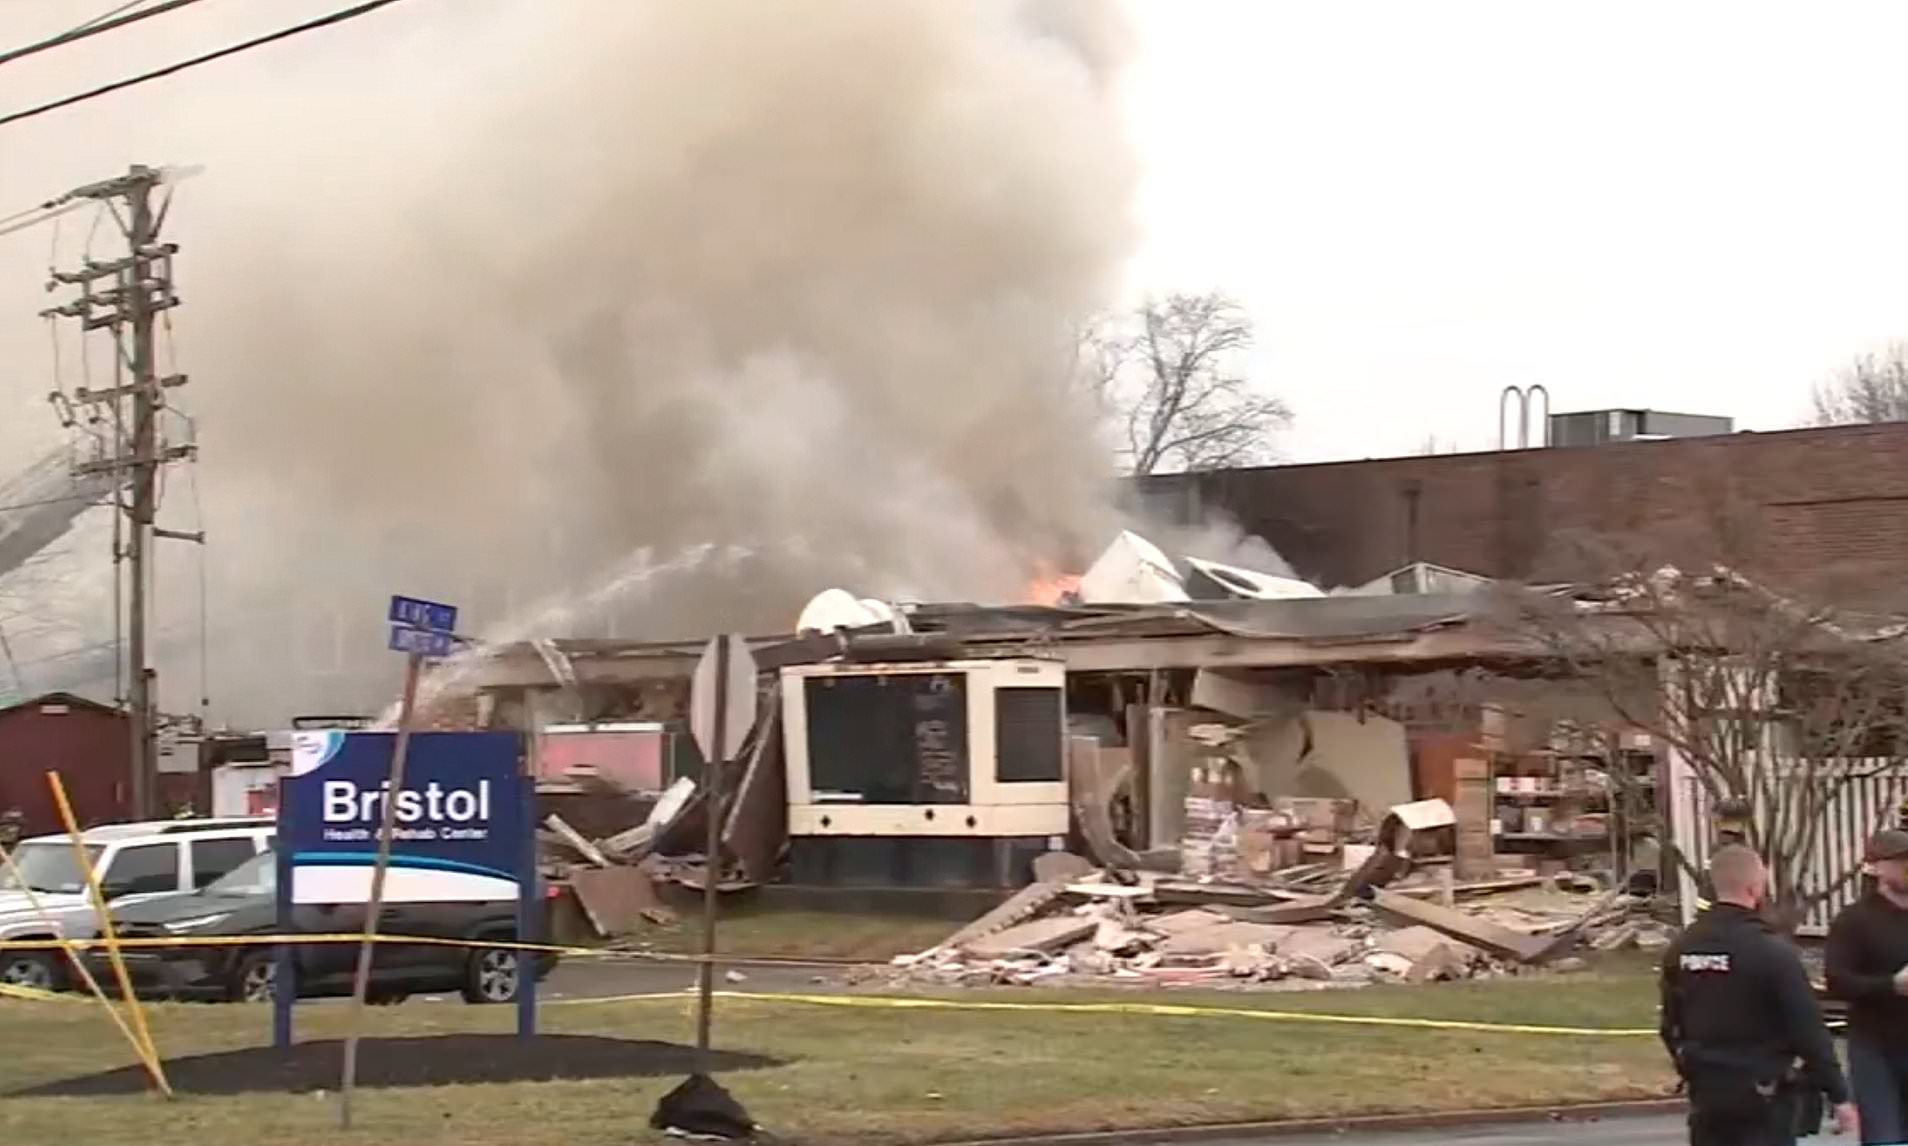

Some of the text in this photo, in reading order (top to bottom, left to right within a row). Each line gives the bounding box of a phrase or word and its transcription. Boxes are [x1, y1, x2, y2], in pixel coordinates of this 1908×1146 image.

[323, 780, 489, 822] Bristol
[323, 828, 370, 841] Health
[440, 827, 489, 841] Center
[1679, 953, 1730, 972] POLICE
